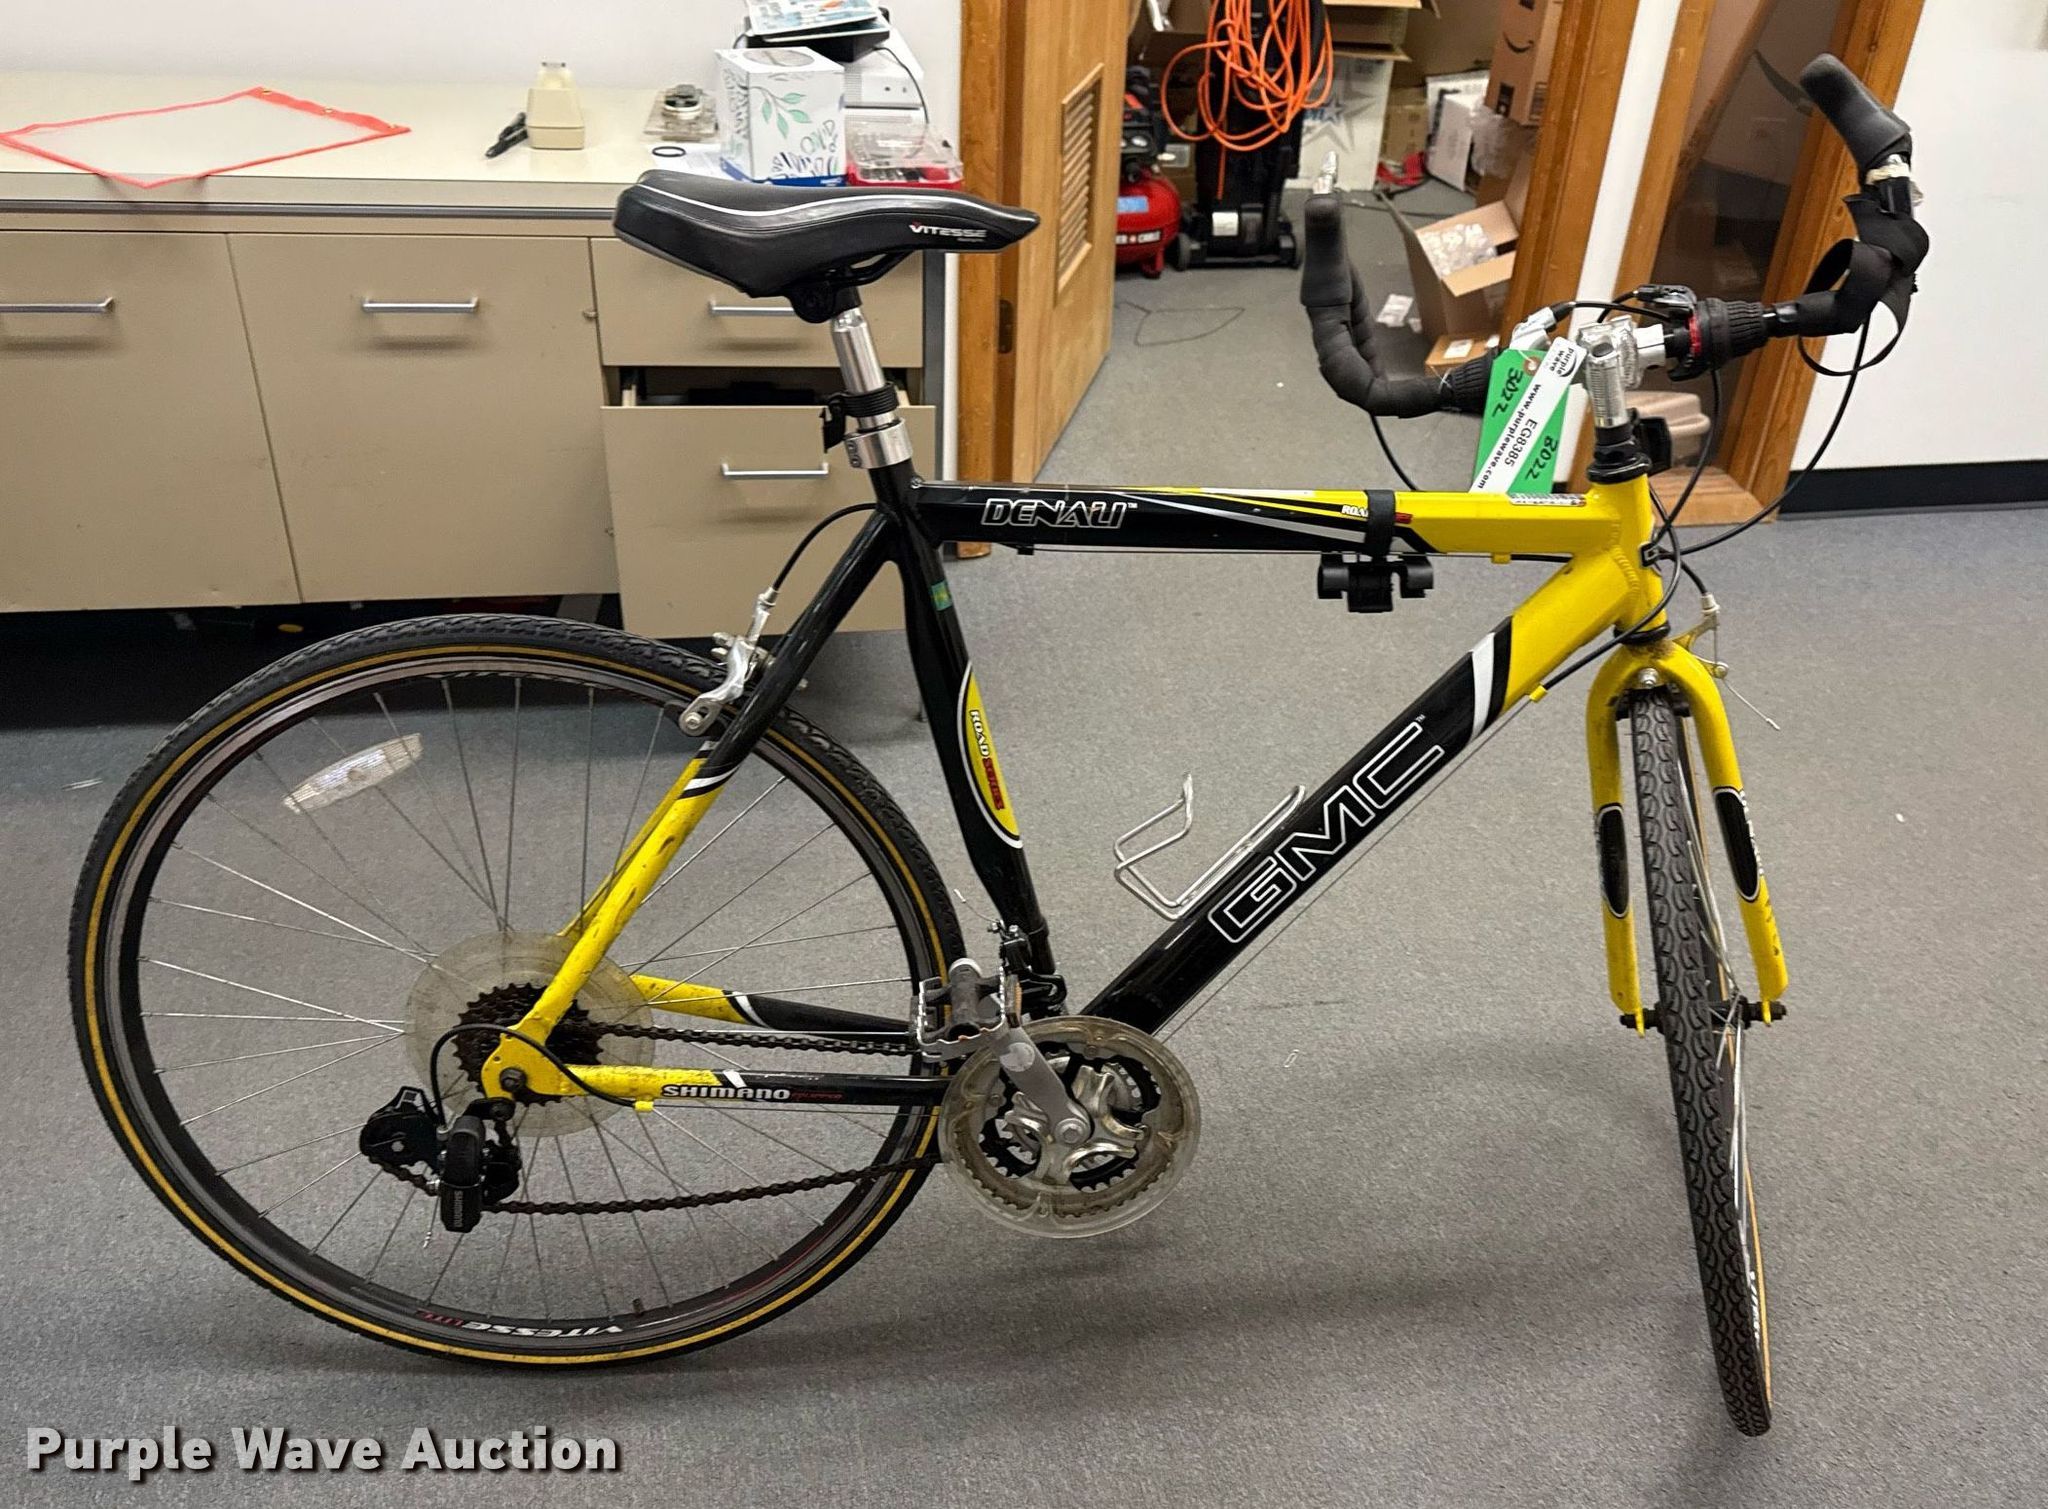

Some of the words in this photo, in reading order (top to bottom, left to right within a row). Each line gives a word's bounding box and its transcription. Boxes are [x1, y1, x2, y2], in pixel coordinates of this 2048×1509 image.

[909, 221, 987, 237] VITESSE
[1550, 350, 1565, 371] wave
[1557, 348, 1575, 375] purple
[1477, 383, 1541, 489] www.purplewave.com
[1504, 418, 1538, 467] EG8385
[1208, 721, 1445, 943] GMC
[663, 1085, 791, 1100] SHIMANO
[463, 1320, 624, 1338] VITESSE
